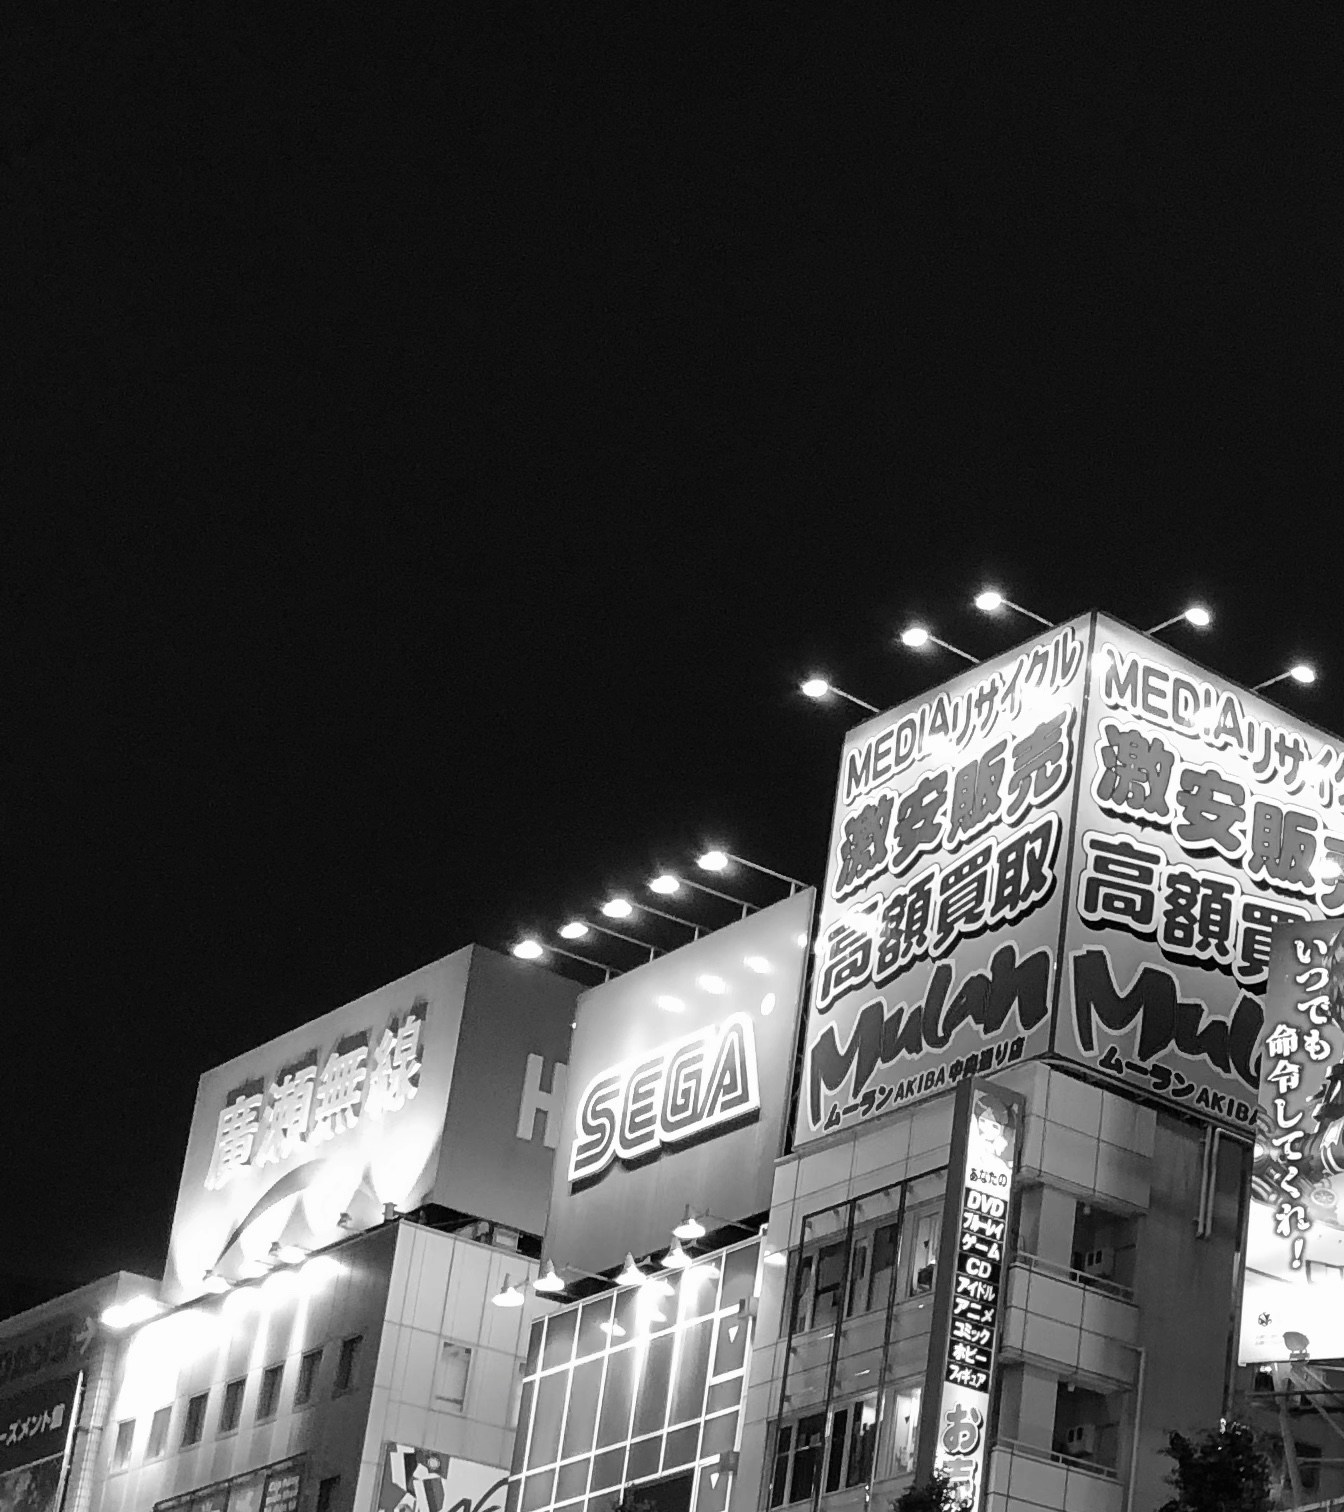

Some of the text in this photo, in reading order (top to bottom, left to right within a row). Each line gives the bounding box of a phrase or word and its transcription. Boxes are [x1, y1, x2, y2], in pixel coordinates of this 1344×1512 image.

[832, 707, 1077, 899] 激安販売
[815, 813, 1062, 1011] 高額買取
[1294, 937, 1332, 1061] いつでも
[568, 1011, 761, 1183] SEGA
[966, 1189, 1005, 1218] DVD
[961, 1232, 1001, 1261] ゲーム
[965, 1257, 992, 1279] CD
[956, 1275, 996, 1303] アイドル
[953, 1297, 995, 1323] アニメ
[952, 1321, 991, 1345] コミック
